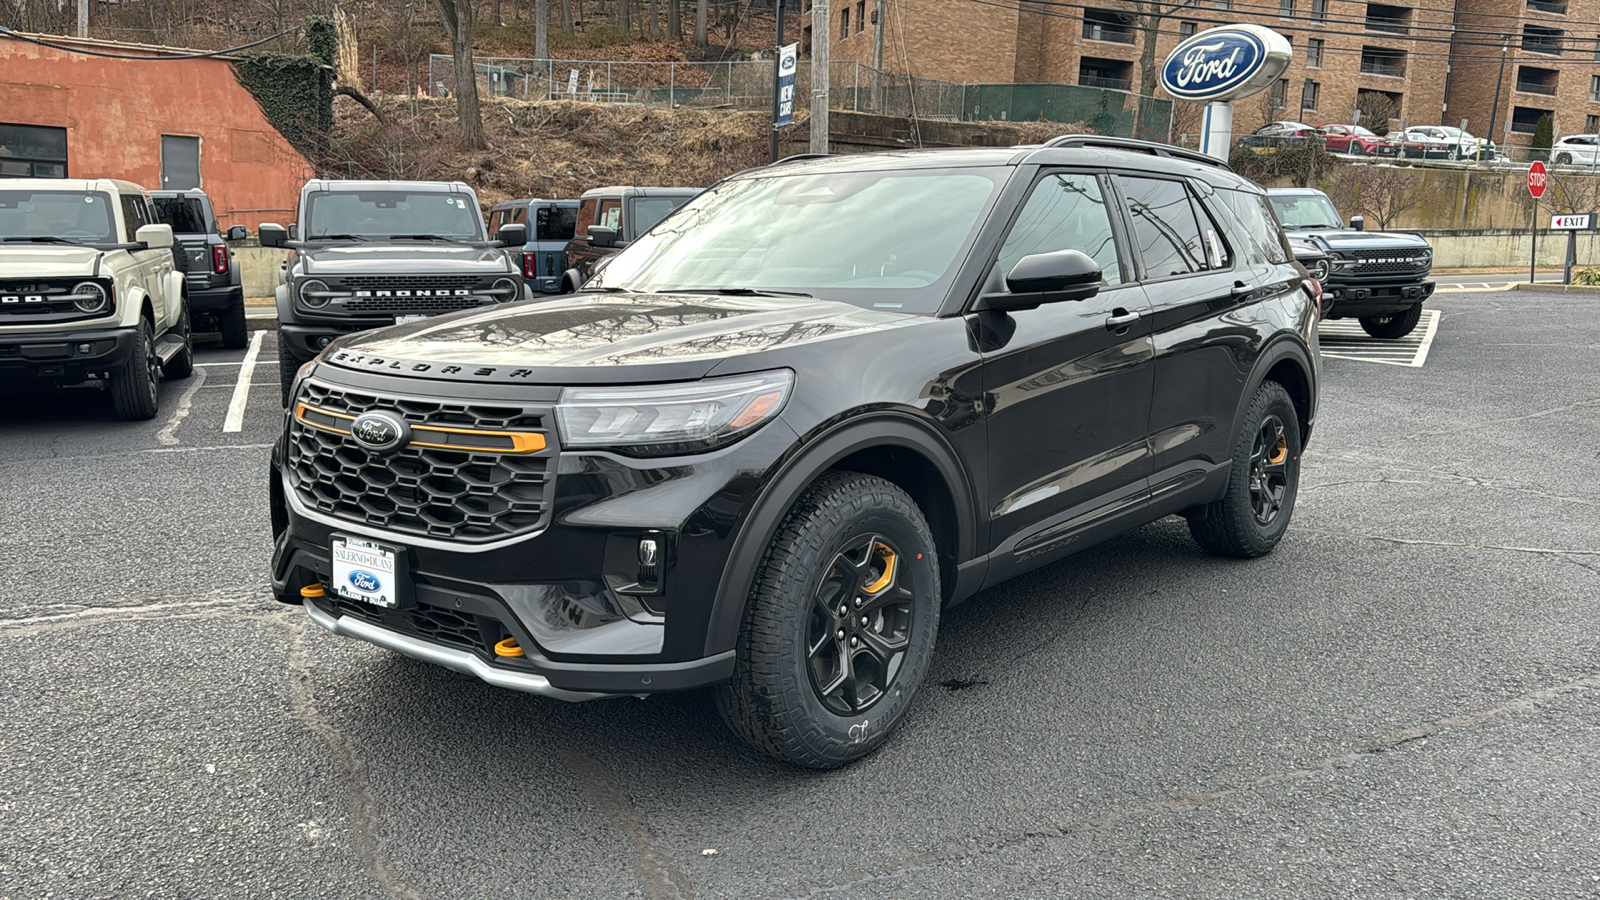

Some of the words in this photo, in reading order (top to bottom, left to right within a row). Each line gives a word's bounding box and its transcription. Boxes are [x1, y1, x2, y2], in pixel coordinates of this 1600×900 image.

[1177, 41, 1240, 87] Ford
[781, 85, 793, 102] NEW
[780, 101, 792, 116] CARS
[1529, 172, 1546, 187] STOP
[1563, 217, 1585, 227] EXIT
[334, 352, 533, 378] EXPLORER
[358, 419, 388, 443] Ford
[335, 549, 366, 562] SALERNO
[370, 556, 393, 570] DUANE
[354, 572, 376, 590] Ford
